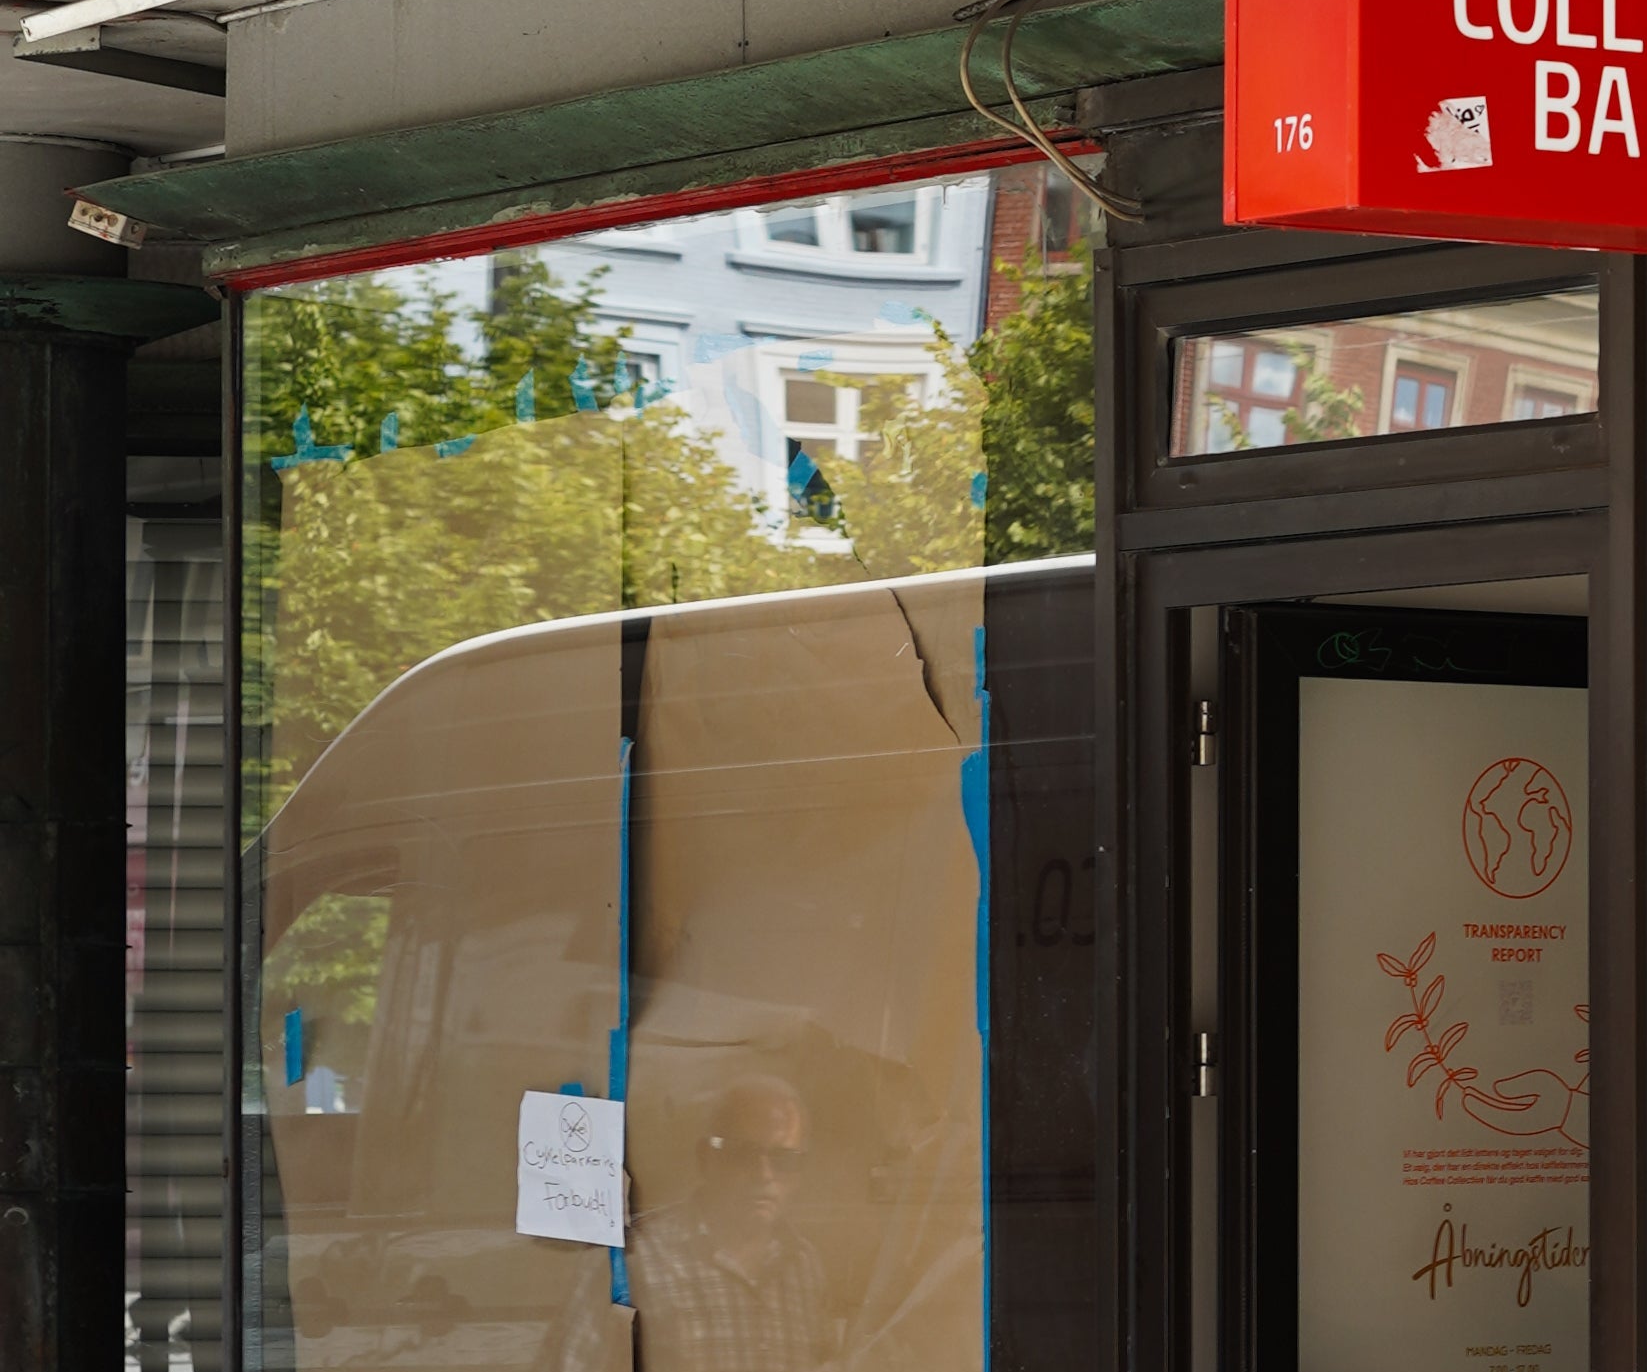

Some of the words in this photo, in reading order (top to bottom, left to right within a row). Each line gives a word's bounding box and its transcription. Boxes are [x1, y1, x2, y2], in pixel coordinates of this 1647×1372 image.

[1272, 112, 1315, 154] 176
[1463, 923, 1567, 941] TRANSPARENCY
[1491, 948, 1543, 963] REPORT
